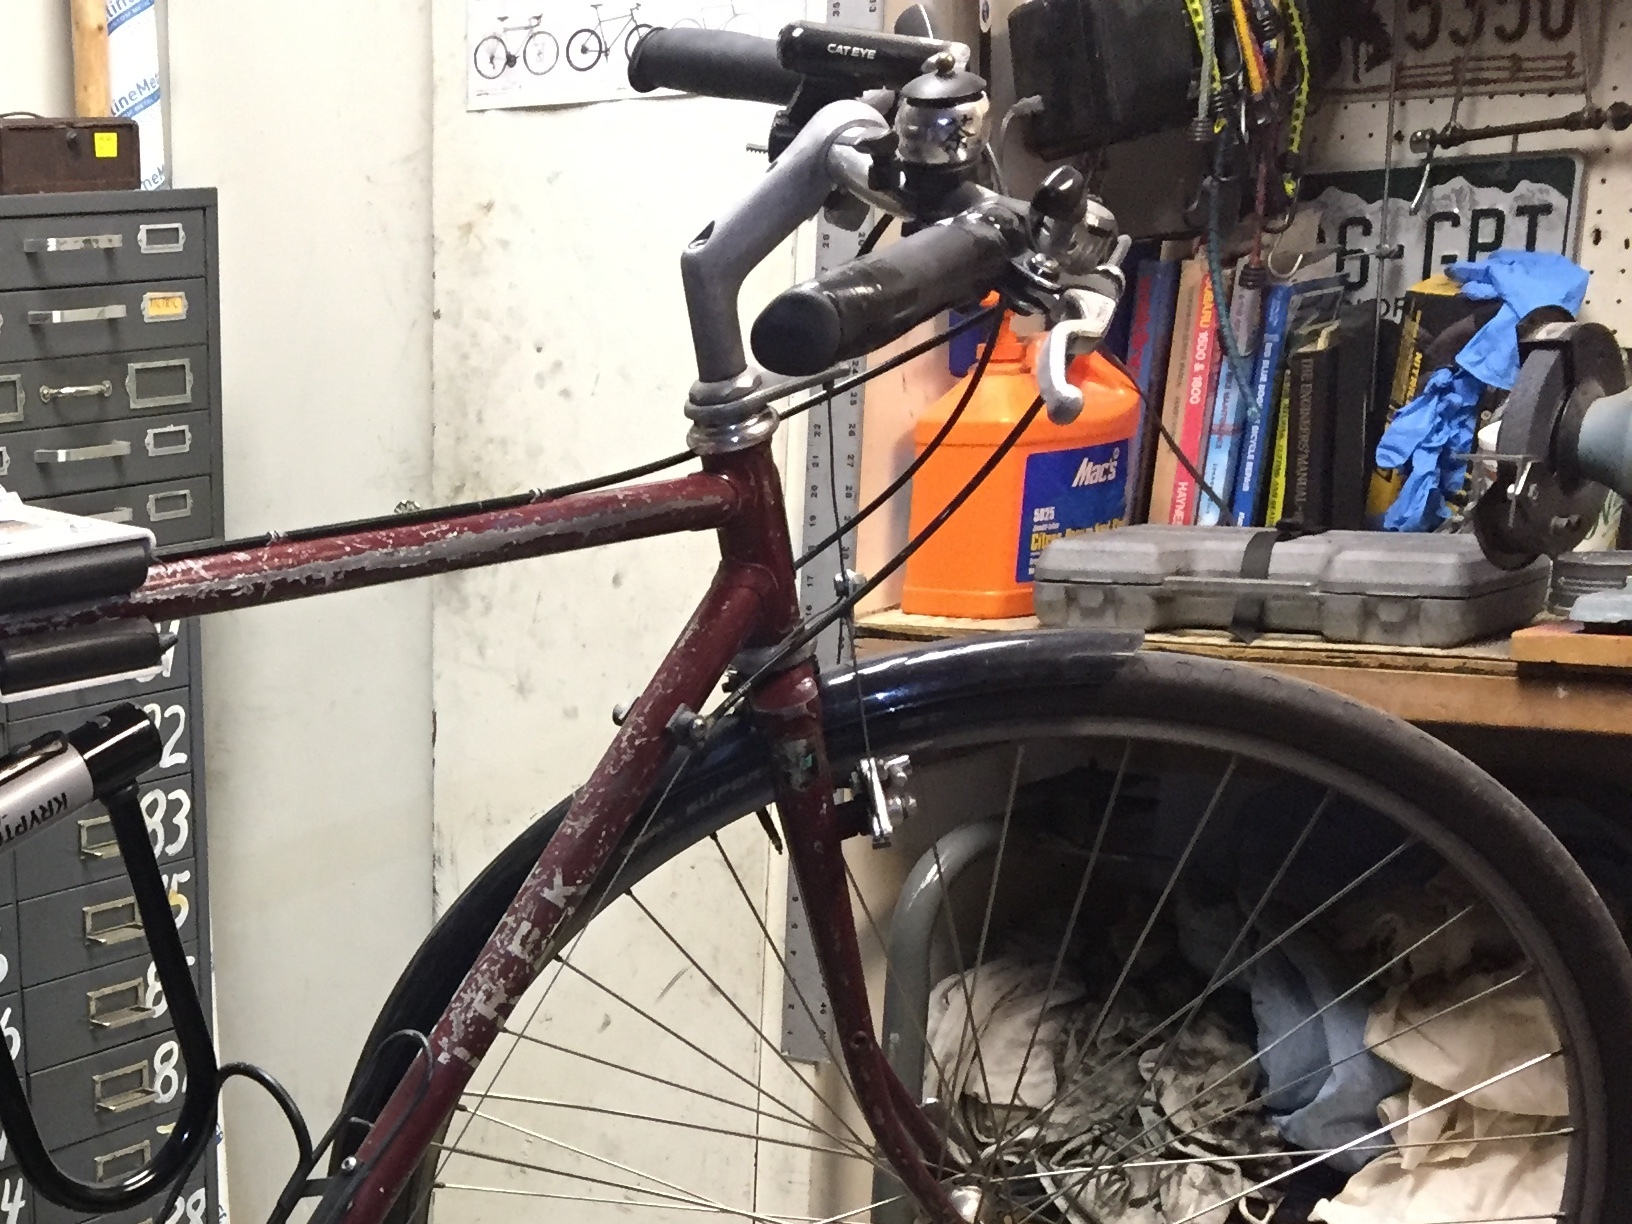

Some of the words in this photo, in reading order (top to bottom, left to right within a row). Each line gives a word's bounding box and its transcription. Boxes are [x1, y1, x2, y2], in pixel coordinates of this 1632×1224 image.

[826, 42, 877, 60] CATEYE
[1301, 358, 1314, 382] THE
[1071, 456, 1118, 488] Mac's
[144, 702, 188, 769] 2
[153, 1040, 188, 1104] 8
